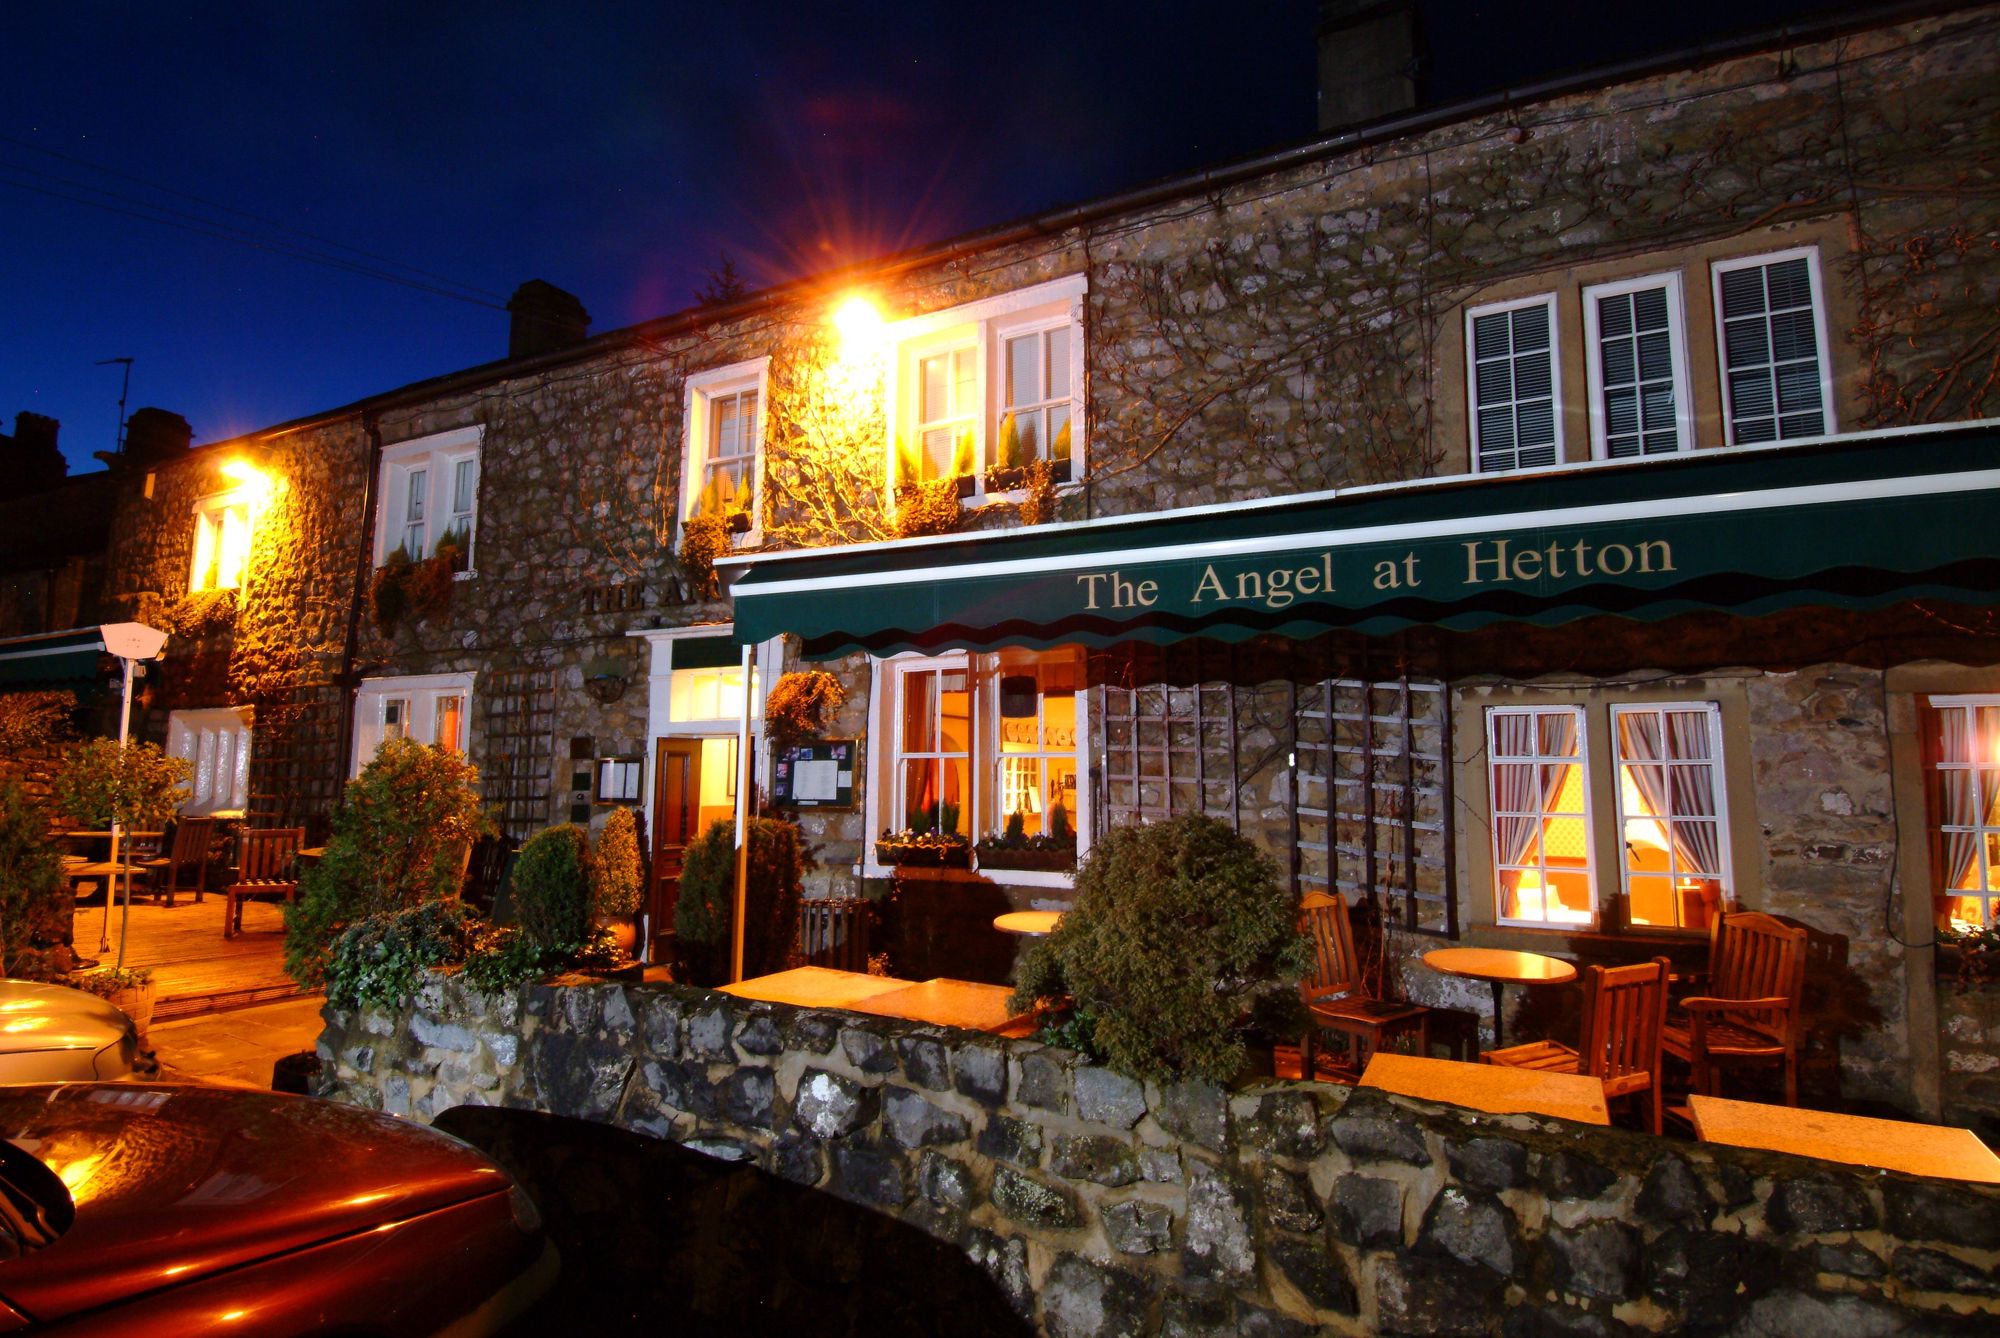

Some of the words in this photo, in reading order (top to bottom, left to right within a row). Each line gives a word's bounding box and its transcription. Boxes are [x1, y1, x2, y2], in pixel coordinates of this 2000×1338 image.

[1076, 571, 1158, 609] The
[1190, 552, 1335, 609] Angel
[1373, 551, 1421, 590] at
[1461, 538, 1677, 585] Hetton
